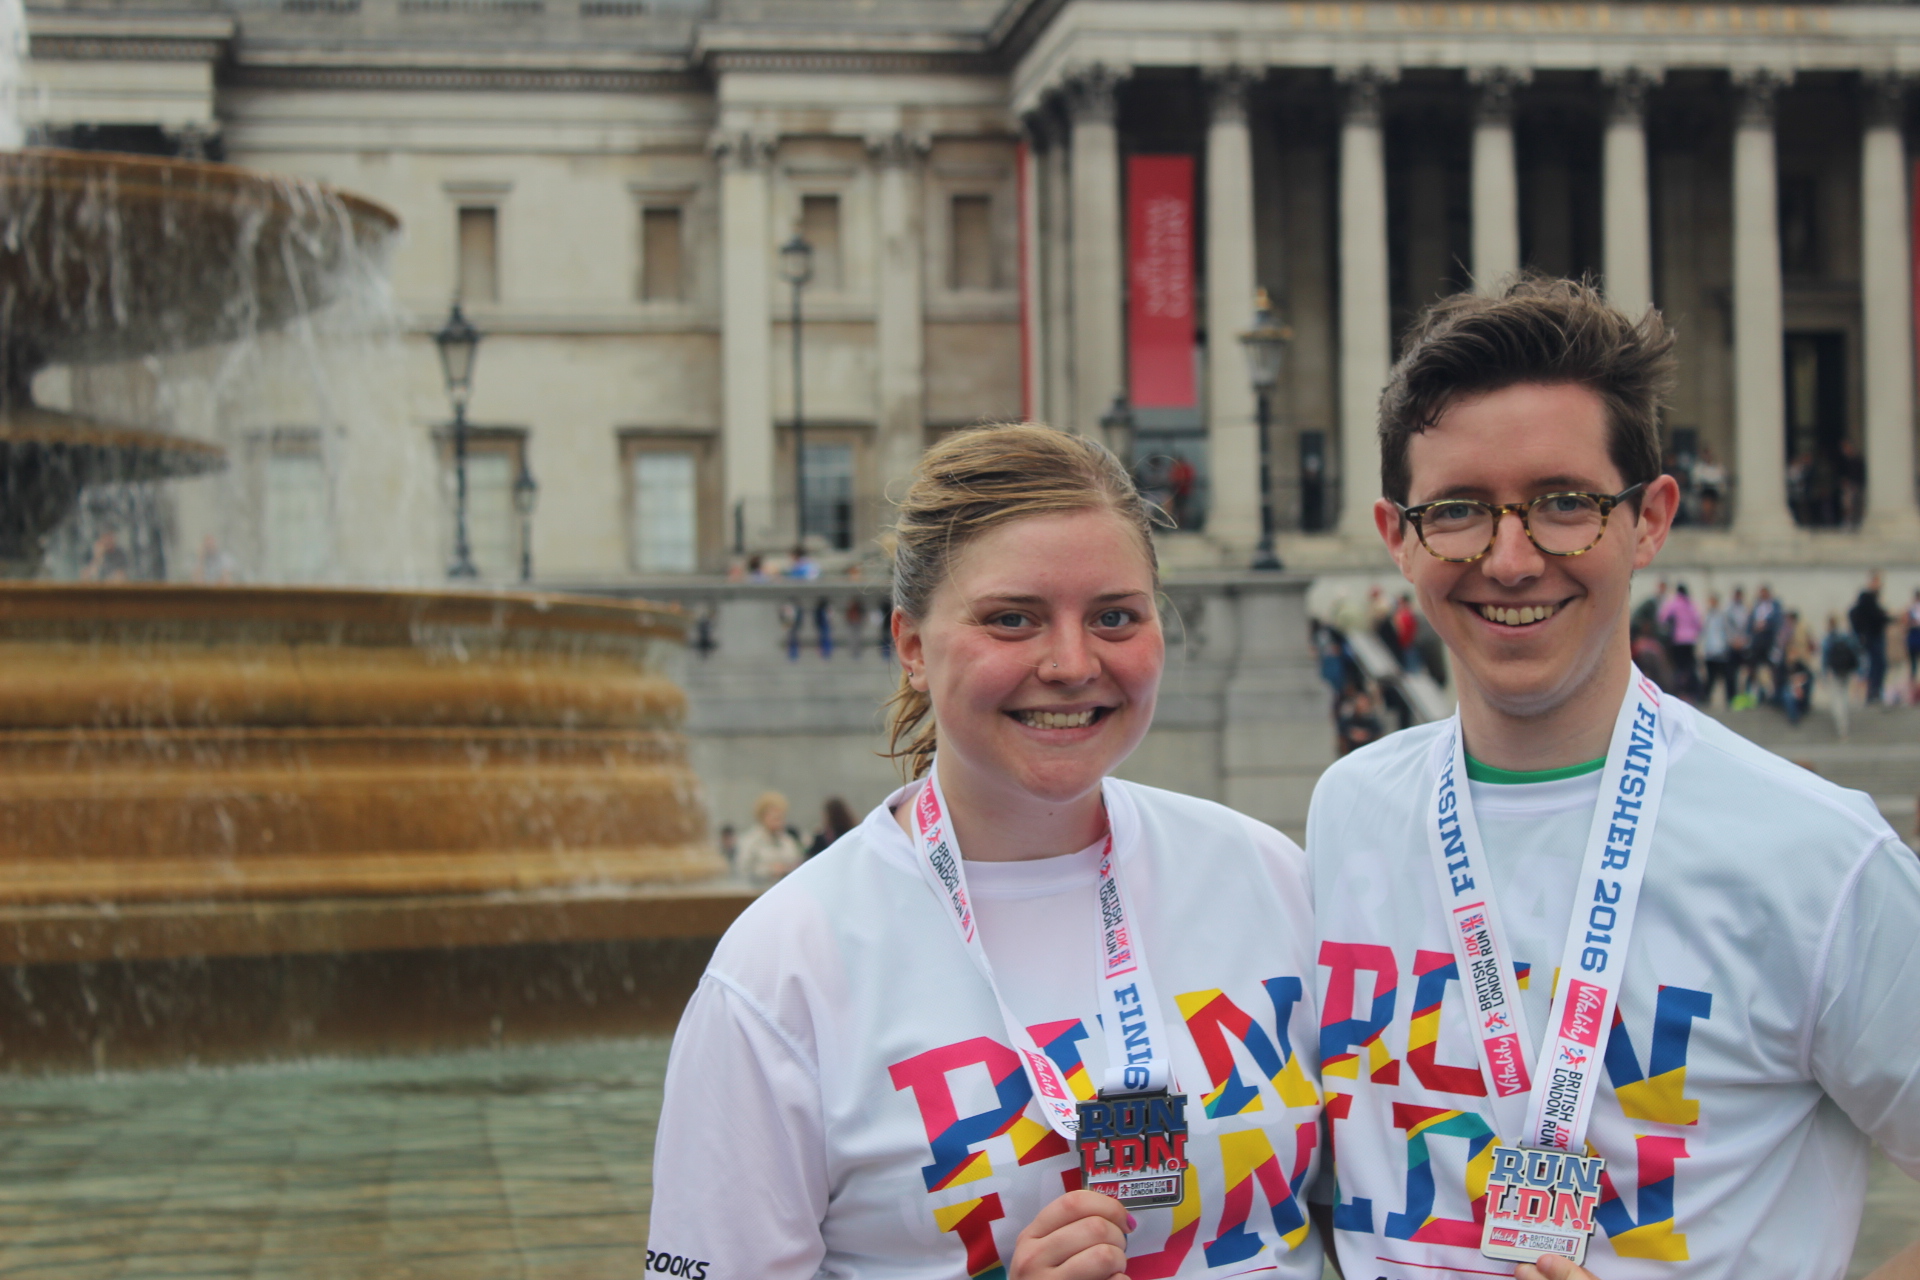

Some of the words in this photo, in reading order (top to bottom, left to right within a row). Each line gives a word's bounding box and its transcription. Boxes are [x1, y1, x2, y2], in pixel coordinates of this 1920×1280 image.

[1601, 702, 1656, 870] FINISHER
[930, 851, 954, 894] LONDON
[952, 892, 963, 918] RUN
[937, 842, 959, 889] BRITISH
[1100, 881, 1112, 930] LONDON
[1107, 877, 1124, 924] BRITISH
[1105, 930, 1118, 955] RUN
[1115, 926, 1129, 947] 10K
[1464, 933, 1480, 957] 10K
[1476, 930, 1495, 957] RUN
[1580, 879, 1621, 973] 2016
[1471, 961, 1492, 1012] BRITISH
[1485, 958, 1505, 1008] LONDON
[1563, 984, 1600, 1041] Vitality
[1493, 1036, 1523, 1095] Vitality
[1545, 1068, 1569, 1117] LONDON
[1560, 1070, 1583, 1122] BRITISH
[1079, 1095, 1187, 1139] RUN
[1540, 1120, 1557, 1147] RUN
[1554, 1125, 1570, 1151] 10K
[1080, 1133, 1187, 1177] LDN
[1489, 1147, 1603, 1193] RUN
[1131, 1188, 1153, 1196] LONDON
[1155, 1186, 1166, 1194] RUN
[1487, 1184, 1597, 1231] LDN
[1491, 1230, 1517, 1246] Vitality
[1529, 1241, 1552, 1250] LONDON
[1553, 1243, 1566, 1252] RUN
[1530, 1235, 1554, 1244] BRITISH
